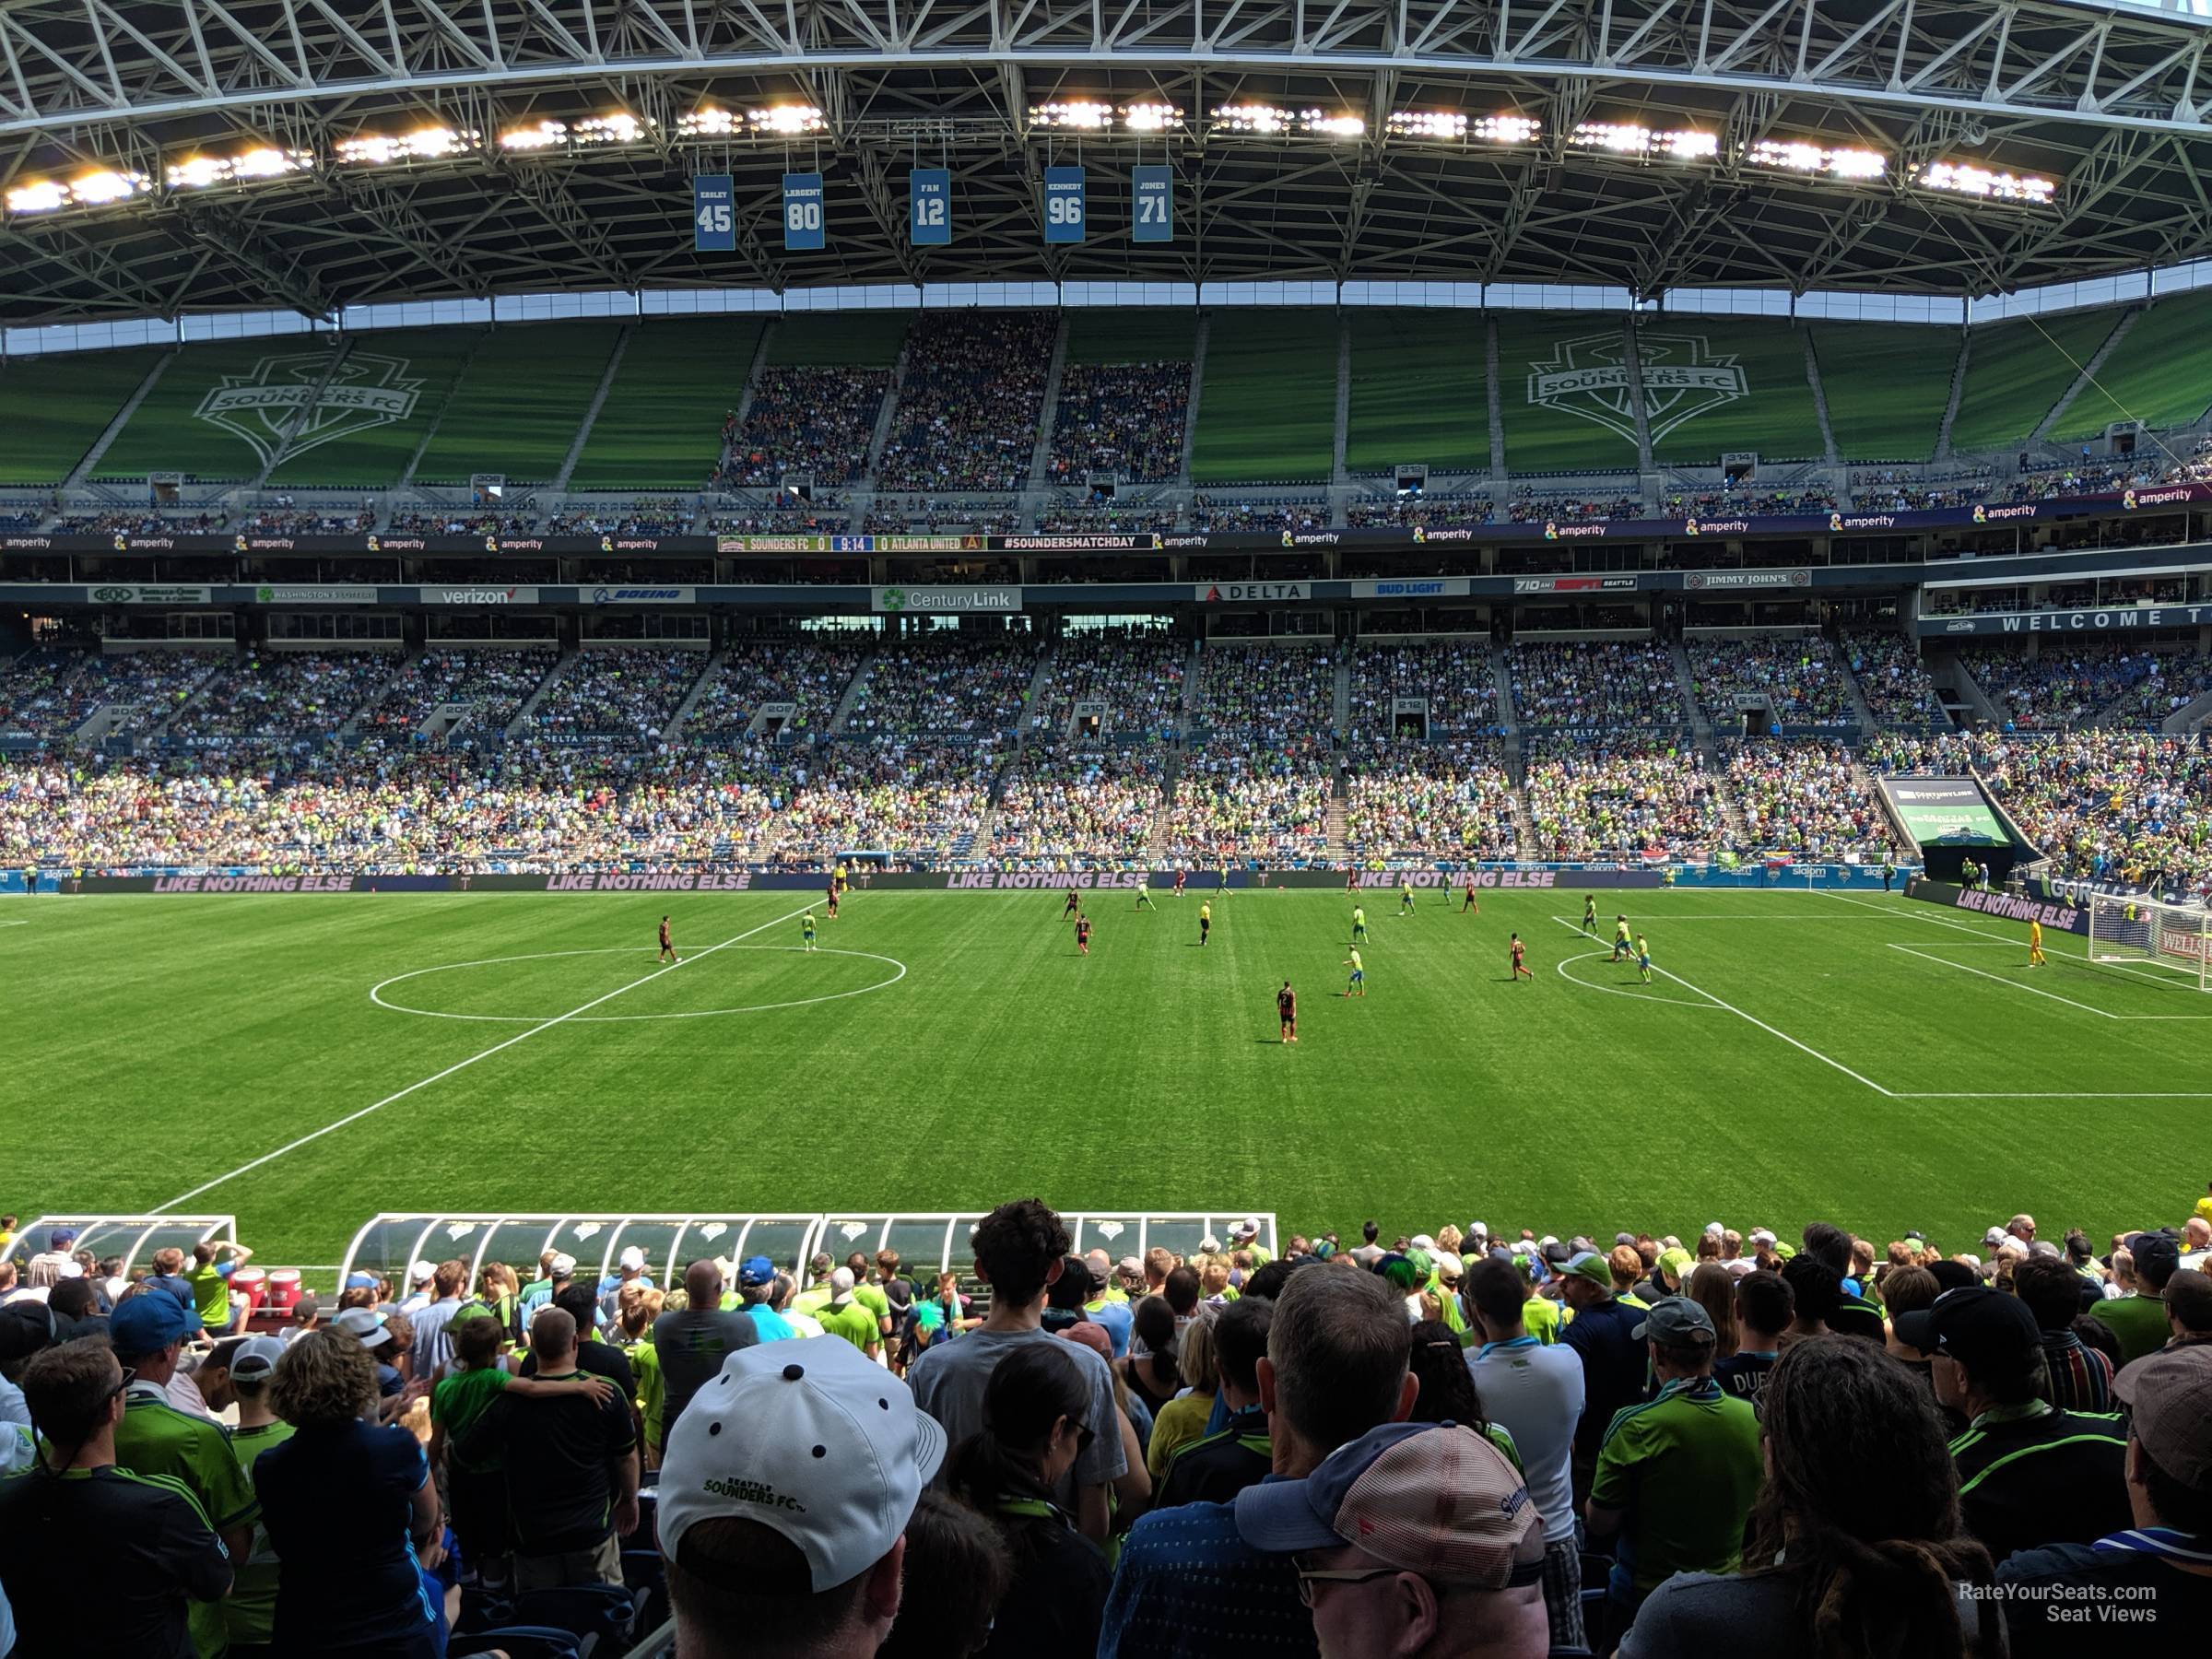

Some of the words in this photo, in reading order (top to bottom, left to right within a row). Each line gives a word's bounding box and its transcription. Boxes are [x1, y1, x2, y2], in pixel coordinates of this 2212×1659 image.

[784, 188, 821, 197] LARGENT
[921, 184, 940, 193] FAN
[1139, 182, 1166, 190] JONES
[700, 191, 728, 199] EASLEY
[916, 198, 945, 226] 12
[1048, 196, 1081, 224] 96
[1138, 195, 1167, 223] 71
[697, 205, 731, 232] 45
[788, 203, 820, 230] 80
[1700, 375, 1734, 387] FC
[371, 396, 402, 411] FC
[2138, 488, 2192, 506] amperity
[1987, 504, 2037, 520] amperity
[1700, 520, 1748, 533] amperity
[1844, 515, 1895, 529] amperity
[1426, 528, 1473, 542] amperity
[1559, 524, 1606, 538] amperity
[6, 536, 52, 548] amperity
[130, 536, 174, 549] amperity
[251, 537, 295, 549] amperity
[383, 538, 425, 550] amperity
[501, 538, 543, 550] amperity
[617, 538, 658, 550] amperity
[750, 537, 796, 550] SOUNDERS
[797, 537, 809, 550] FC
[818, 536, 826, 551] 0
[841, 537, 865, 551] 9:14
[880, 537, 888, 551] 0
[891, 537, 929, 550] ATLANTA
[930, 537, 961, 550] UNITED
[1004, 535, 1136, 549] #SOUNDERSMATCHDAY
[1164, 535, 1208, 548] amperity
[1294, 532, 1340, 546] amperity
[1516, 580, 1540, 591] 710
[1603, 579, 1634, 587] SEATTLE
[1706, 574, 1745, 585] JIMMY
[1747, 574, 1787, 585] JOHN'S
[615, 590, 681, 599] BOEING
[1230, 585, 1300, 599] DELTA
[1377, 583, 1405, 594] BUD
[1406, 582, 1443, 594] LIGHT
[441, 588, 508, 605] verizon
[910, 590, 1010, 609] CenturyLink
[2002, 609, 2161, 632] WELCOME
[1397, 700, 1421, 709] 212
[1737, 696, 1762, 705] 214
[1081, 704, 1105, 712] 210
[1500, 871, 1556, 887] ELSE
[1793, 867, 1827, 877] slalom
[154, 877, 201, 892] LIKE
[203, 876, 298, 892] NOTHING
[300, 876, 354, 891] ELSE
[547, 875, 594, 890] LIKE
[597, 875, 695, 890] NOTHING
[698, 875, 752, 890] ELSE
[947, 872, 994, 888] LIKE
[997, 872, 1094, 888] NOTHING
[1096, 872, 1150, 888] ELSE
[1956, 888, 1984, 912] LIKE
[1985, 894, 2041, 921] NOTHING
[2040, 903, 2078, 930] ELSE
[728, 1477, 772, 1492] SEATTLE
[702, 1479, 775, 1505] SOUNDERS
[776, 1495, 797, 1511] FC
